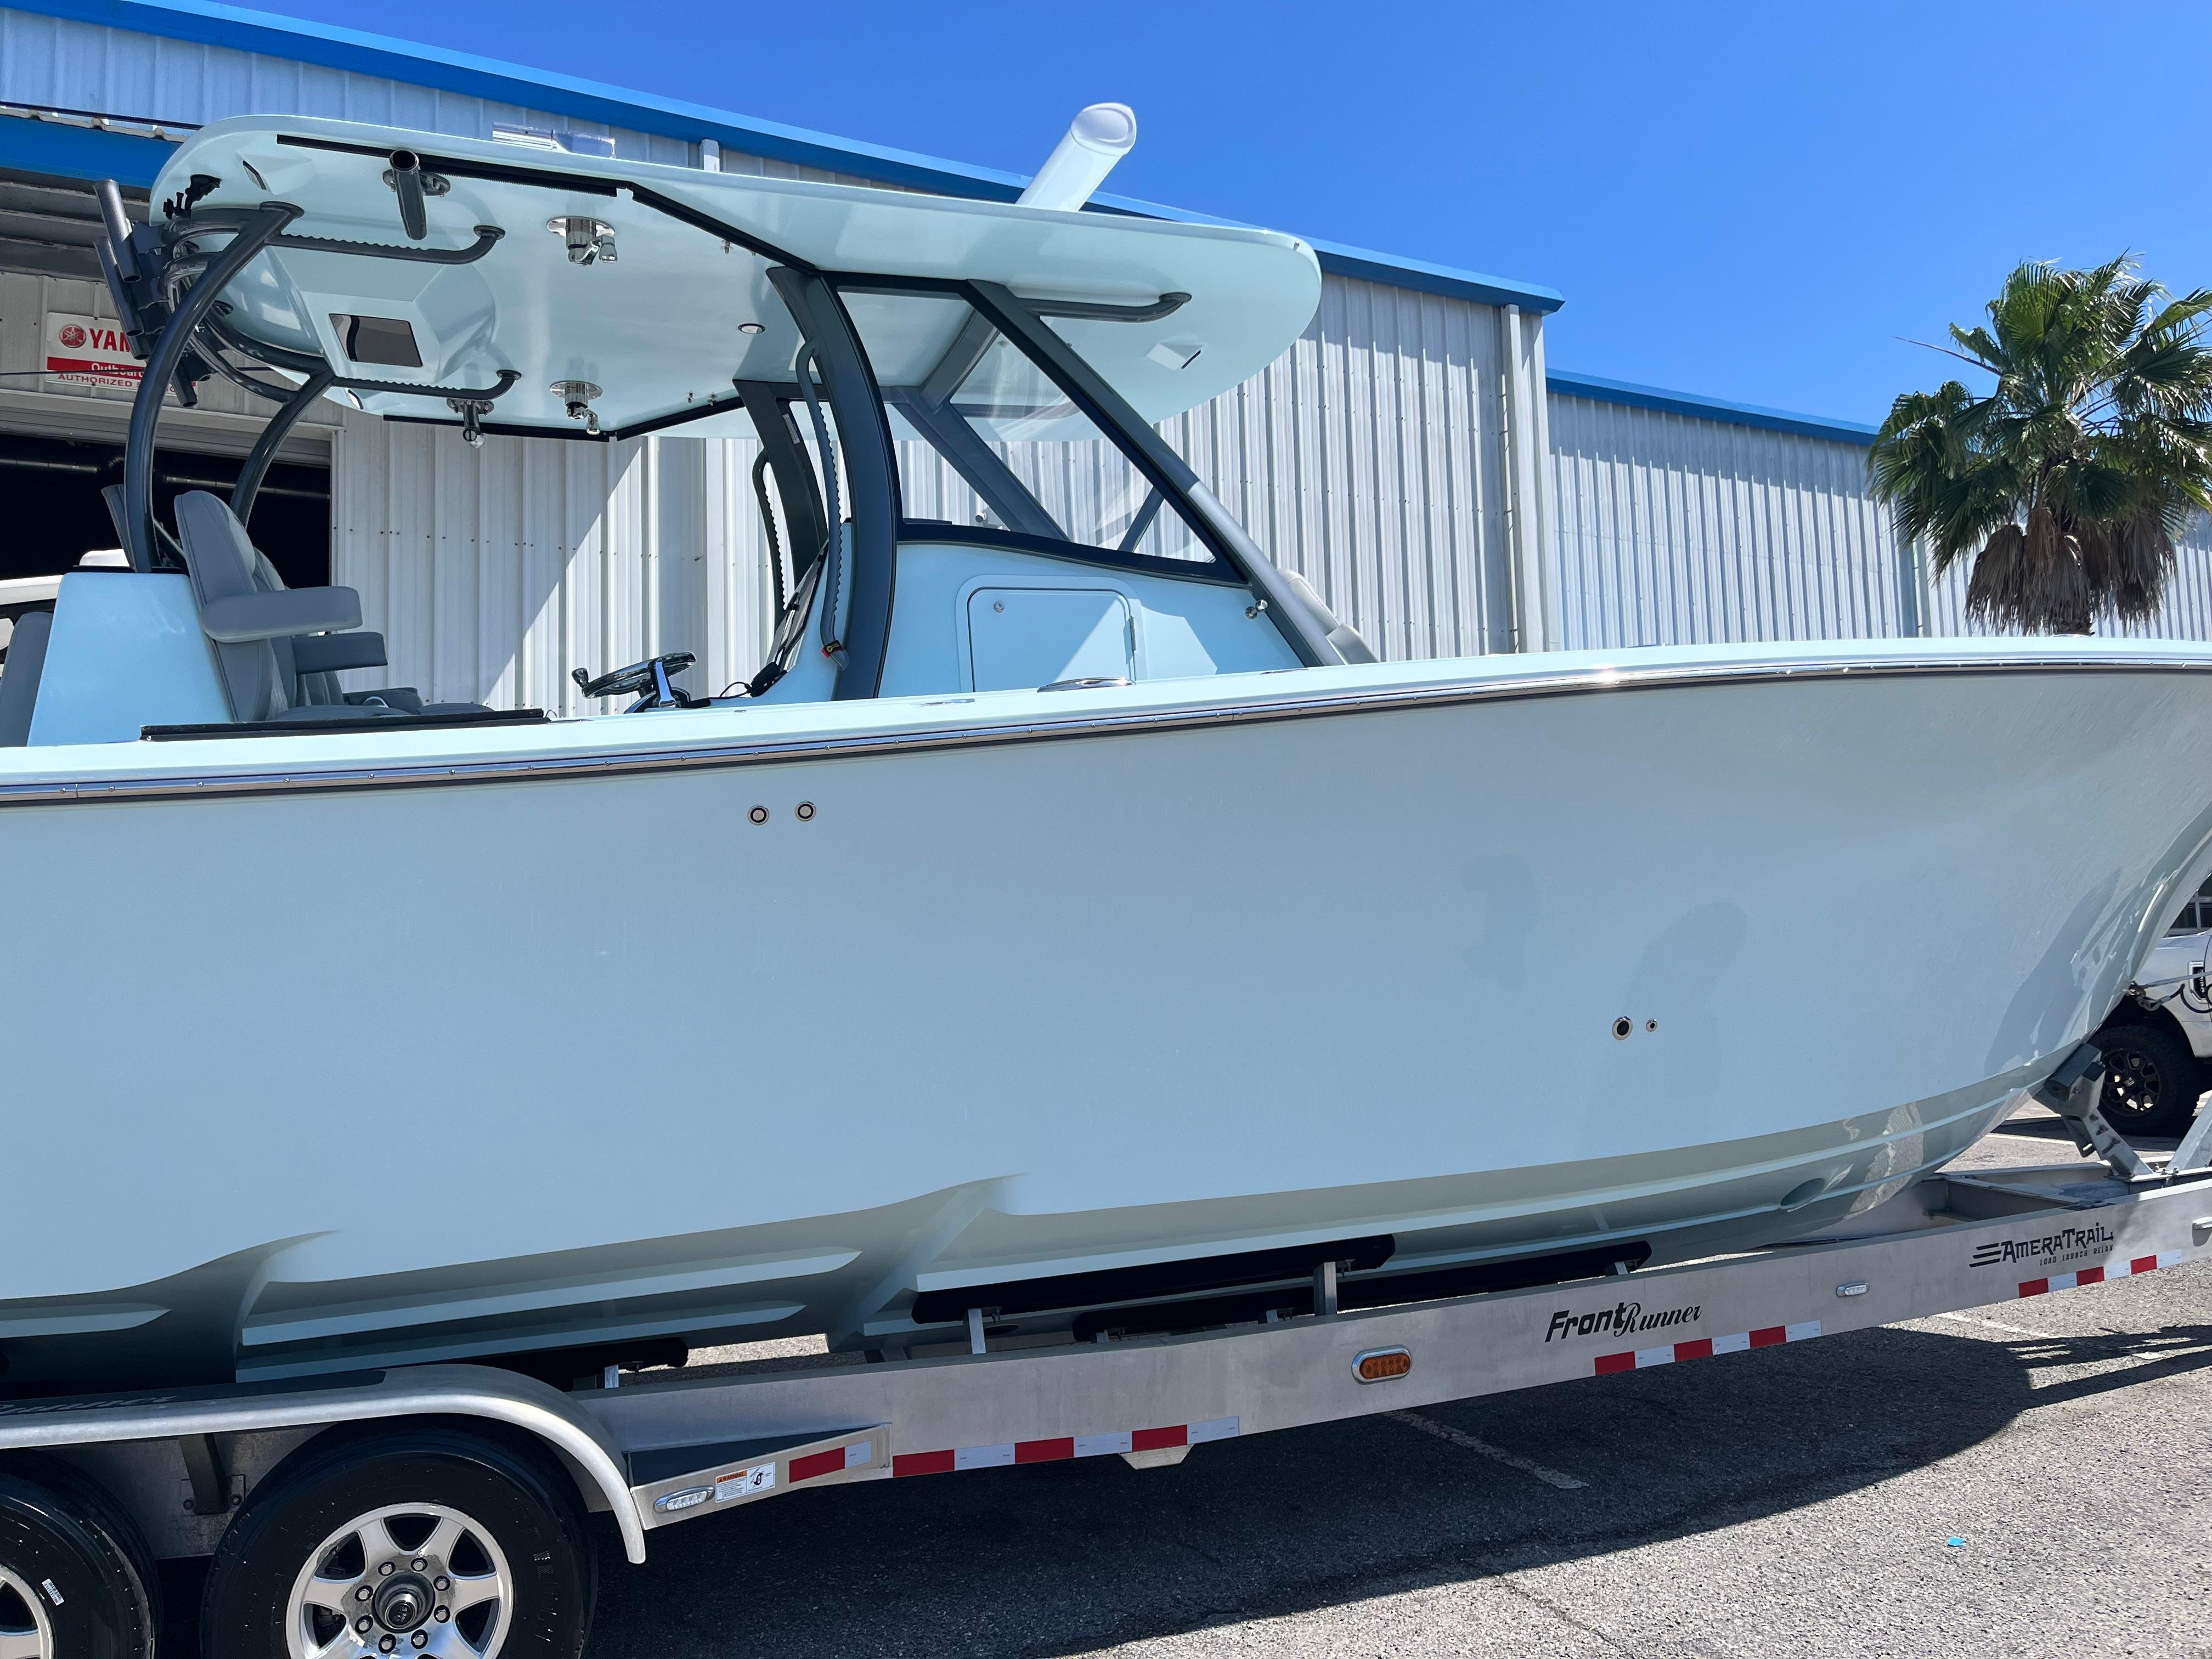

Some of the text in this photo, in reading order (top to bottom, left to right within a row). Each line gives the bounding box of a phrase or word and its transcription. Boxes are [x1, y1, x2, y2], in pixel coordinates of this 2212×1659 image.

[58, 374, 132, 387] AUTHORIZED
[2040, 1244, 2113, 1266] LOAD LAUNCH RELAX
[722, 1471, 744, 1482] WARNING
